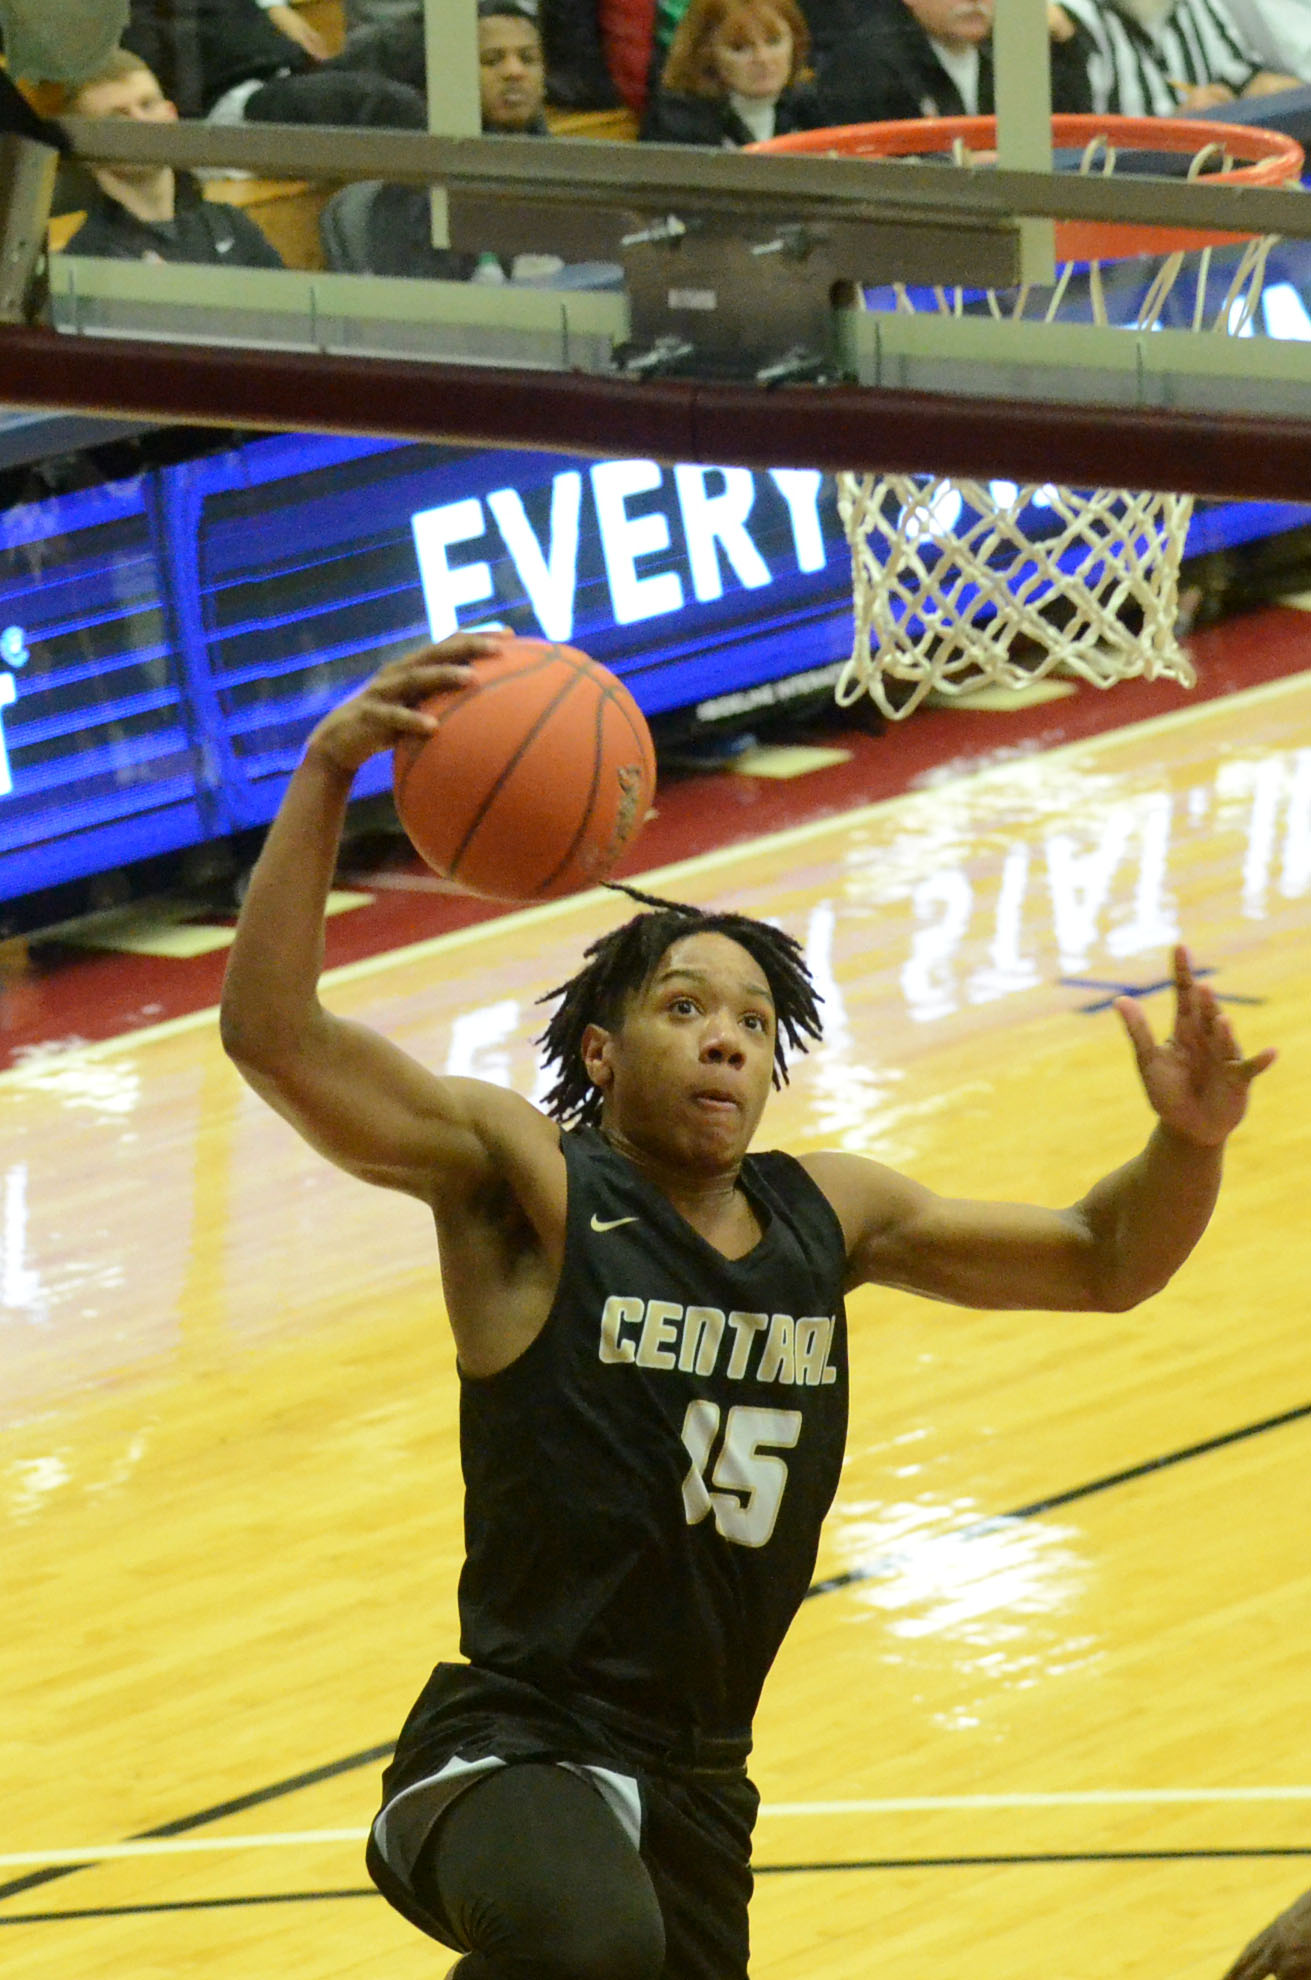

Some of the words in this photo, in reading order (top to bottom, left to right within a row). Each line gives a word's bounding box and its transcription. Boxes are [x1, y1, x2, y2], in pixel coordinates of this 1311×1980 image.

[411, 459, 827, 643] EVERY
[599, 1295, 837, 1386] CENTRAL
[681, 1399, 802, 1549] 15
